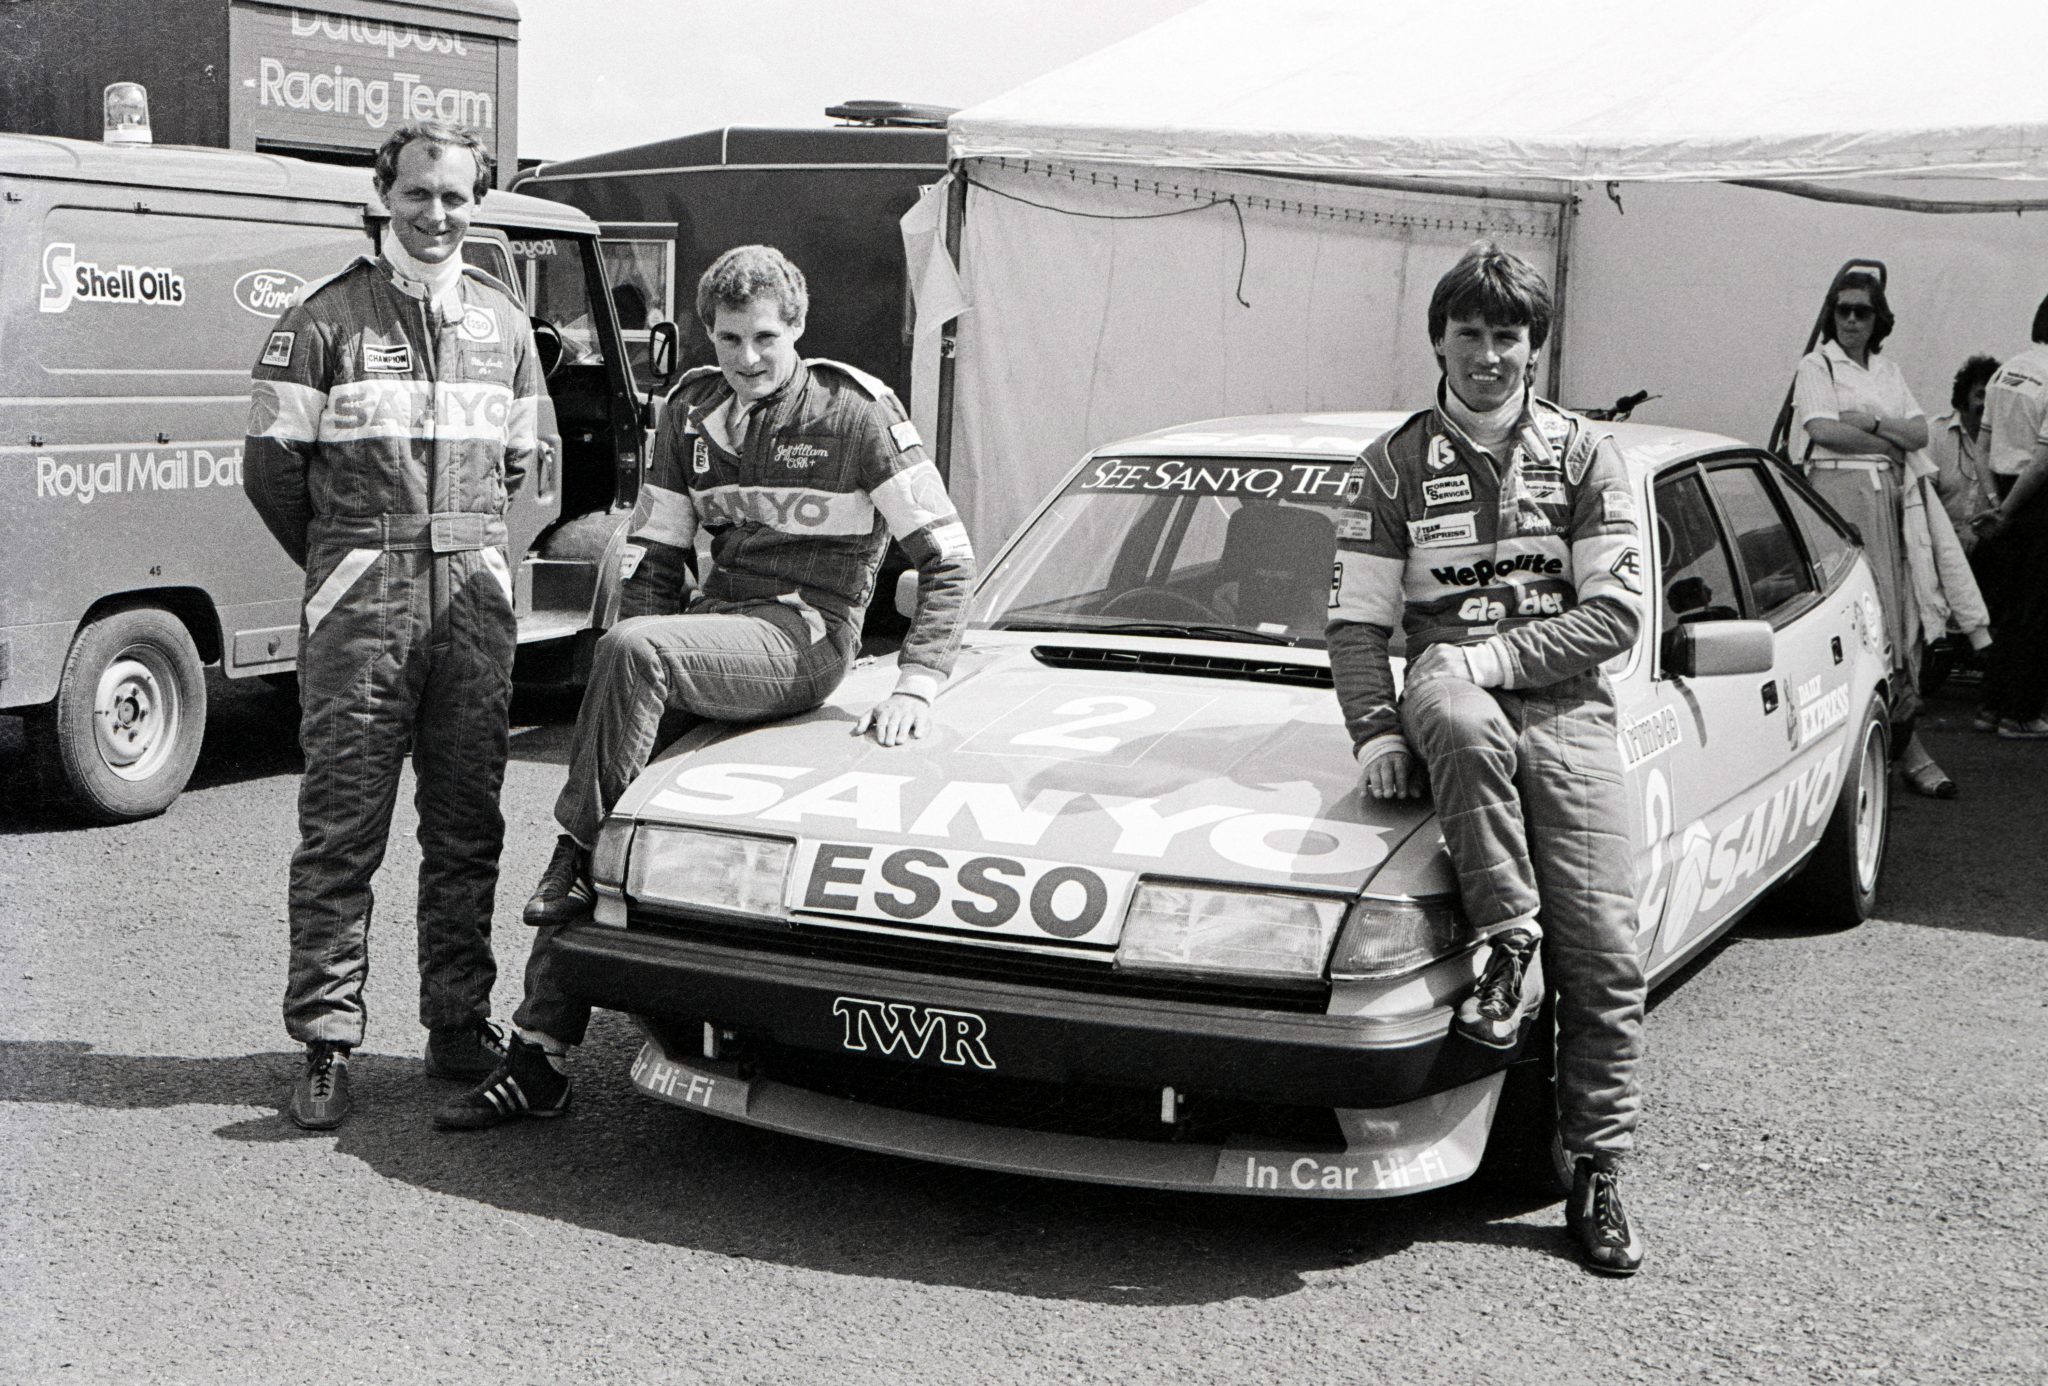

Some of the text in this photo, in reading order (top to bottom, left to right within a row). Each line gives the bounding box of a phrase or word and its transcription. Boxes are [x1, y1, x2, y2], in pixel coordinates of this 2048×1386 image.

[260, 57, 493, 128] Racing Team
[76, 266, 183, 302] Shell Oils
[250, 274, 298, 308] For
[368, 354, 406, 363] CHAMPION
[334, 391, 509, 429] SANYO
[37, 448, 244, 503] Royal Mail Dat
[1081, 459, 1150, 489] SEE
[1290, 464, 1351, 496] TH
[1426, 480, 1466, 496] FORMULA
[701, 490, 834, 527] ANYO
[1430, 489, 1470, 501] SERVICES
[1422, 524, 1441, 533] TEAM
[149, 565, 162, 577] 45
[1430, 554, 1563, 587] Hepolite
[1010, 695, 1157, 753] 2
[1800, 682, 1849, 745] EXPRESS
[654, 763, 1396, 875] SANYO
[1699, 745, 1843, 912] SANYO
[803, 842, 1108, 938] ESSO
[833, 996, 997, 1069] TWR
[648, 1063, 715, 1107] Hi-Fi
[1246, 1149, 1449, 1190] In Car Hi-Fi
